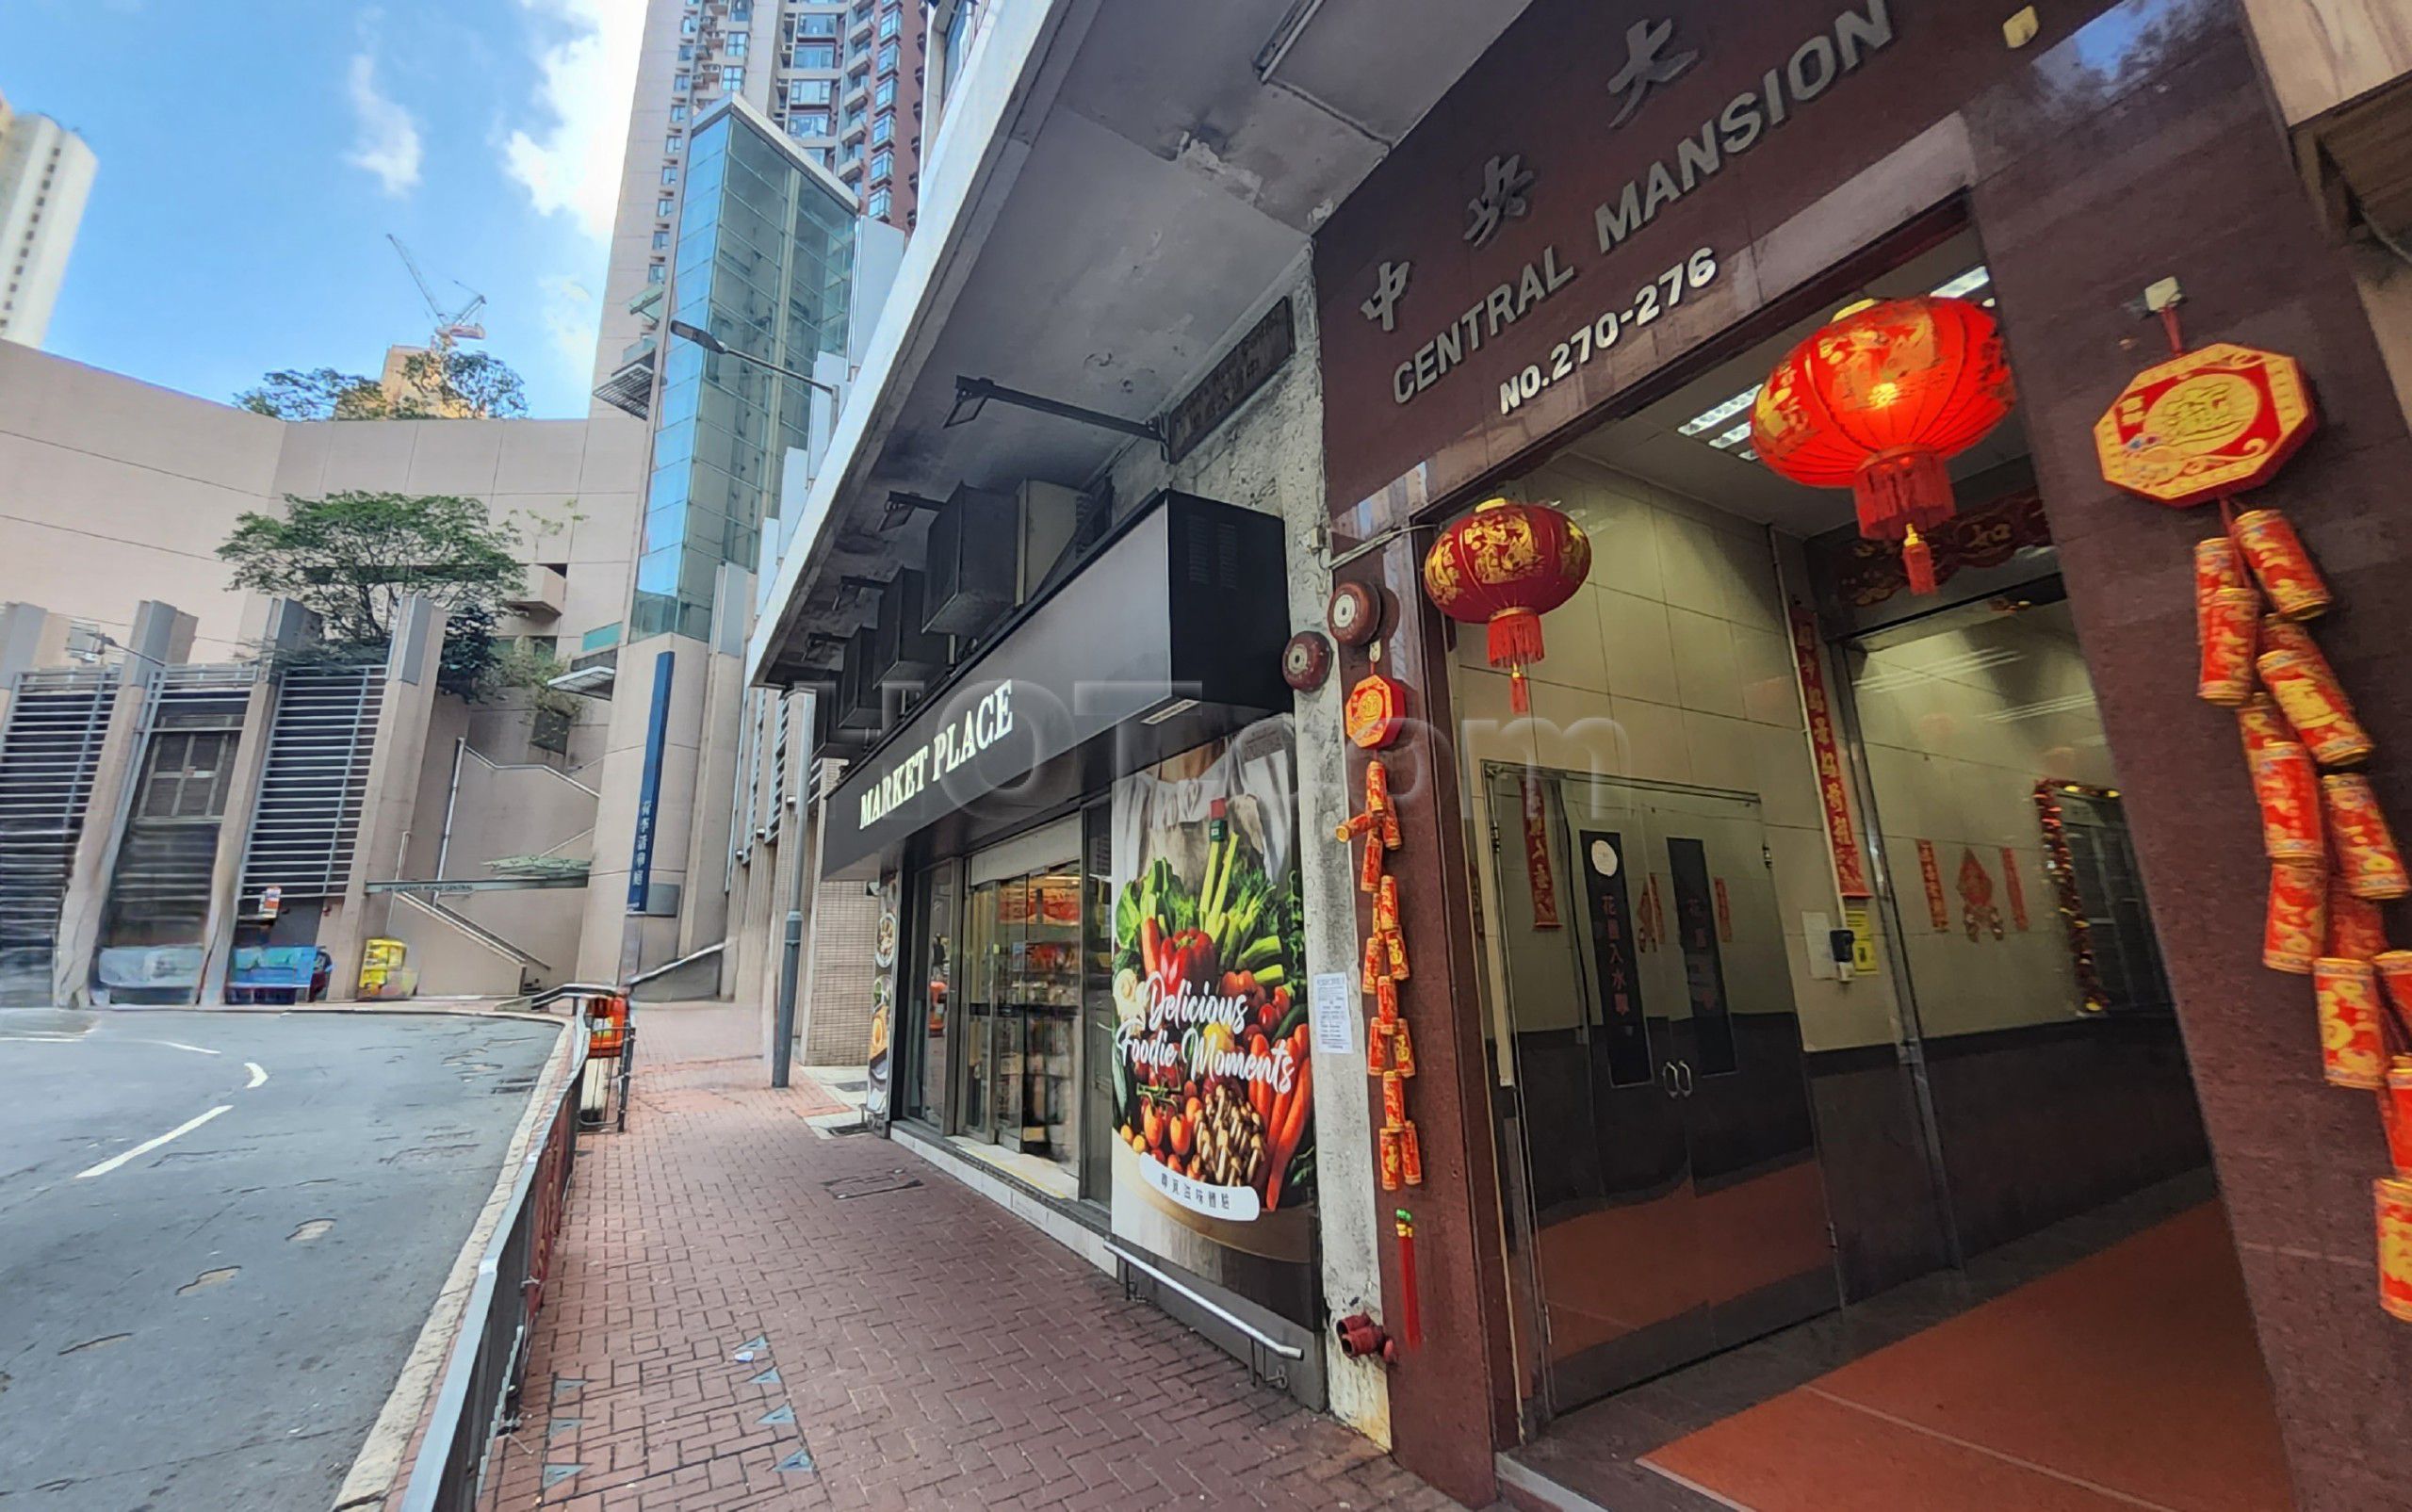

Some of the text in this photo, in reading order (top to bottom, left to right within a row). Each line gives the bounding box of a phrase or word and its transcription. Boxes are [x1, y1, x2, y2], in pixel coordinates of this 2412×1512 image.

[1392, 245, 1574, 405] CENTRAL
[1595, 0, 1894, 254] MANSION
[1499, 246, 1719, 415] NO.270-276
[859, 679, 1013, 831] MARKET PLACE
[1116, 1017, 1296, 1095] Foodie Moments
[1143, 970, 1248, 1034] Delicious
